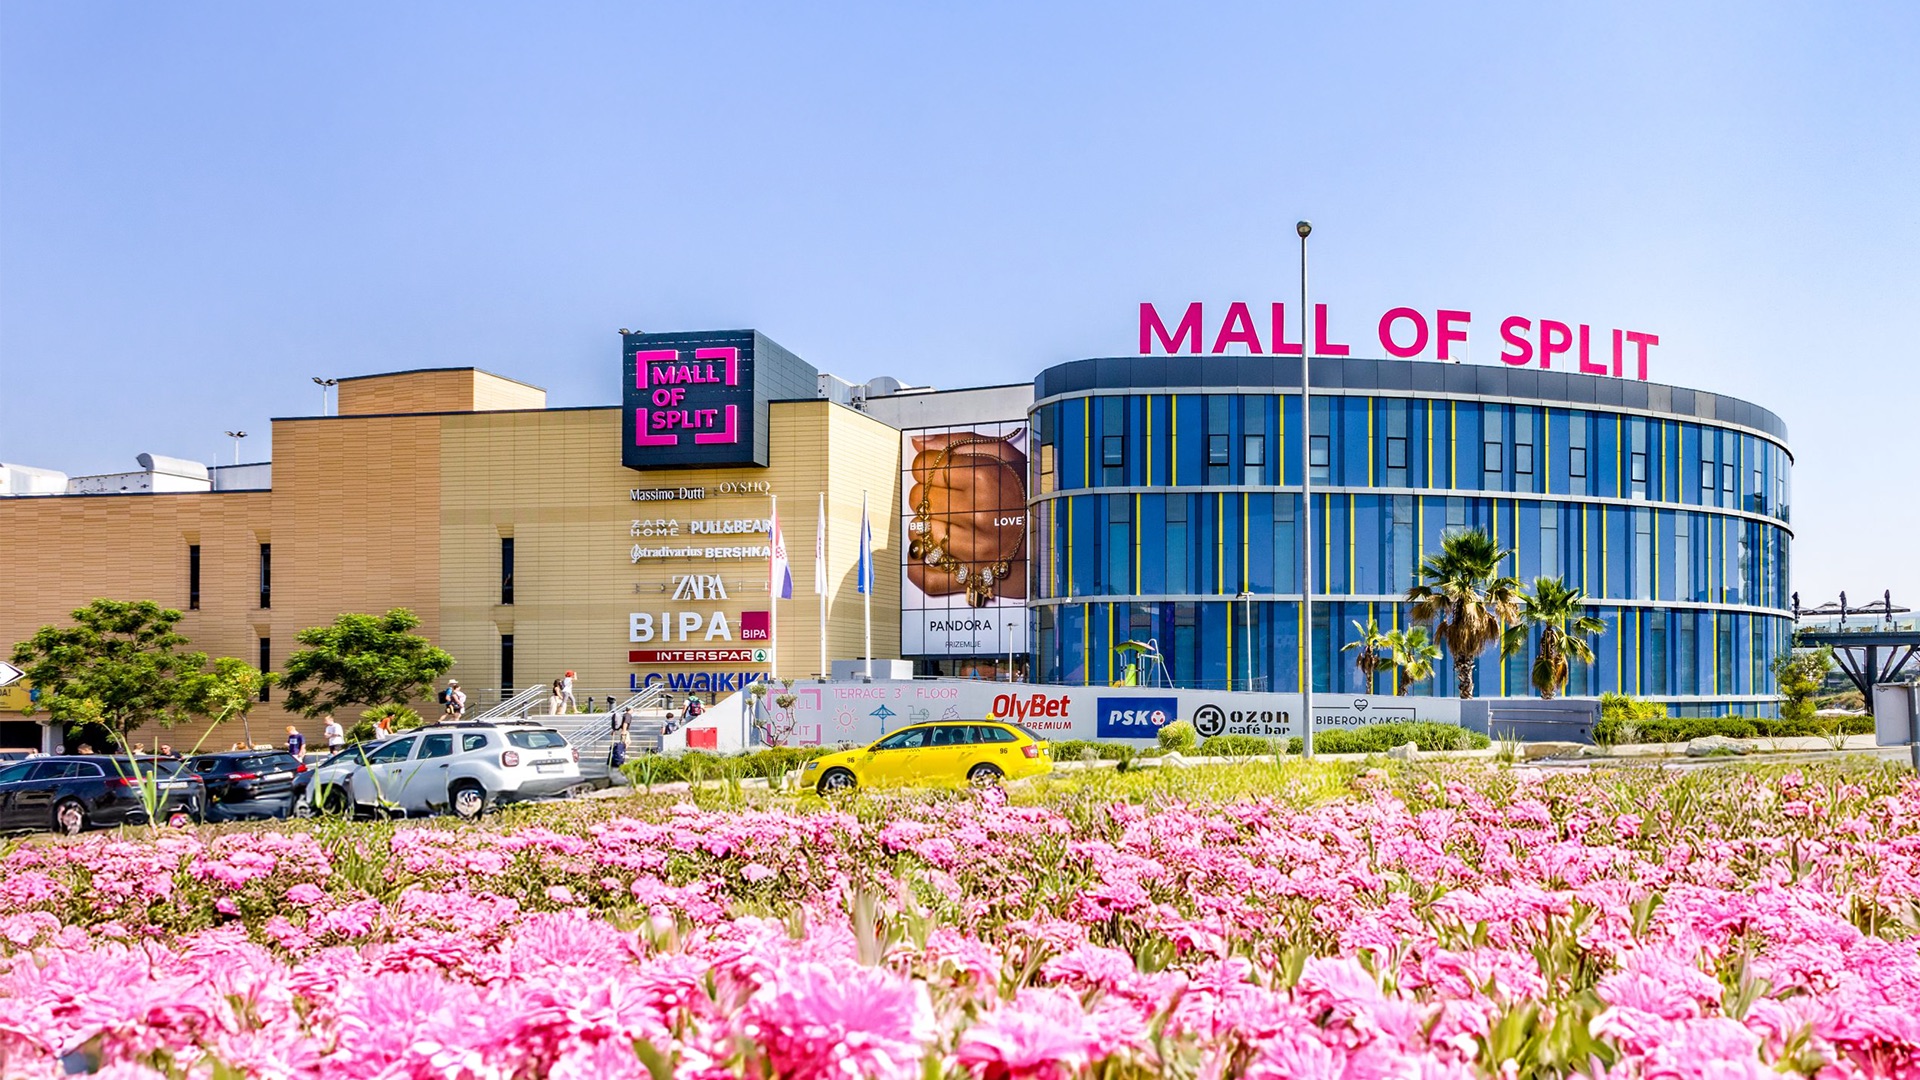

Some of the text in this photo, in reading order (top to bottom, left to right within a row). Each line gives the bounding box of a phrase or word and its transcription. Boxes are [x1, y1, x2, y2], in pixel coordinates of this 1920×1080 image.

[1138, 301, 1660, 381] MALL OF SPLIT
[652, 364, 720, 385] MALL
[651, 387, 686, 407] OF
[651, 409, 718, 430] SPLIT
[719, 480, 770, 494] OYSHO
[630, 487, 705, 501] Massimo Dutti
[631, 519, 679, 528] ZARA
[691, 519, 771, 534] PULL&BEAR
[993, 516, 1023, 527] LOVE
[630, 528, 679, 537] HOME
[704, 546, 771, 559] BERSHKA
[671, 574, 730, 601] ZARA
[629, 611, 732, 643] BIPA
[930, 619, 992, 632] PANDORA
[742, 629, 767, 639] BIPA
[656, 649, 752, 661] INTERSPAR
[630, 672, 664, 693] LC
[833, 688, 886, 699] TERRACE
[916, 687, 958, 699] FLOOR
[992, 693, 1071, 723] OlyBet
[1108, 710, 1151, 726] PSK
[1230, 710, 1290, 723] ozon
[1315, 715, 1407, 726] BIBERON CAKES
[1026, 721, 1072, 730] PREMIUM
[1229, 723, 1291, 735] café bar
[999, 747, 1009, 755] 96
